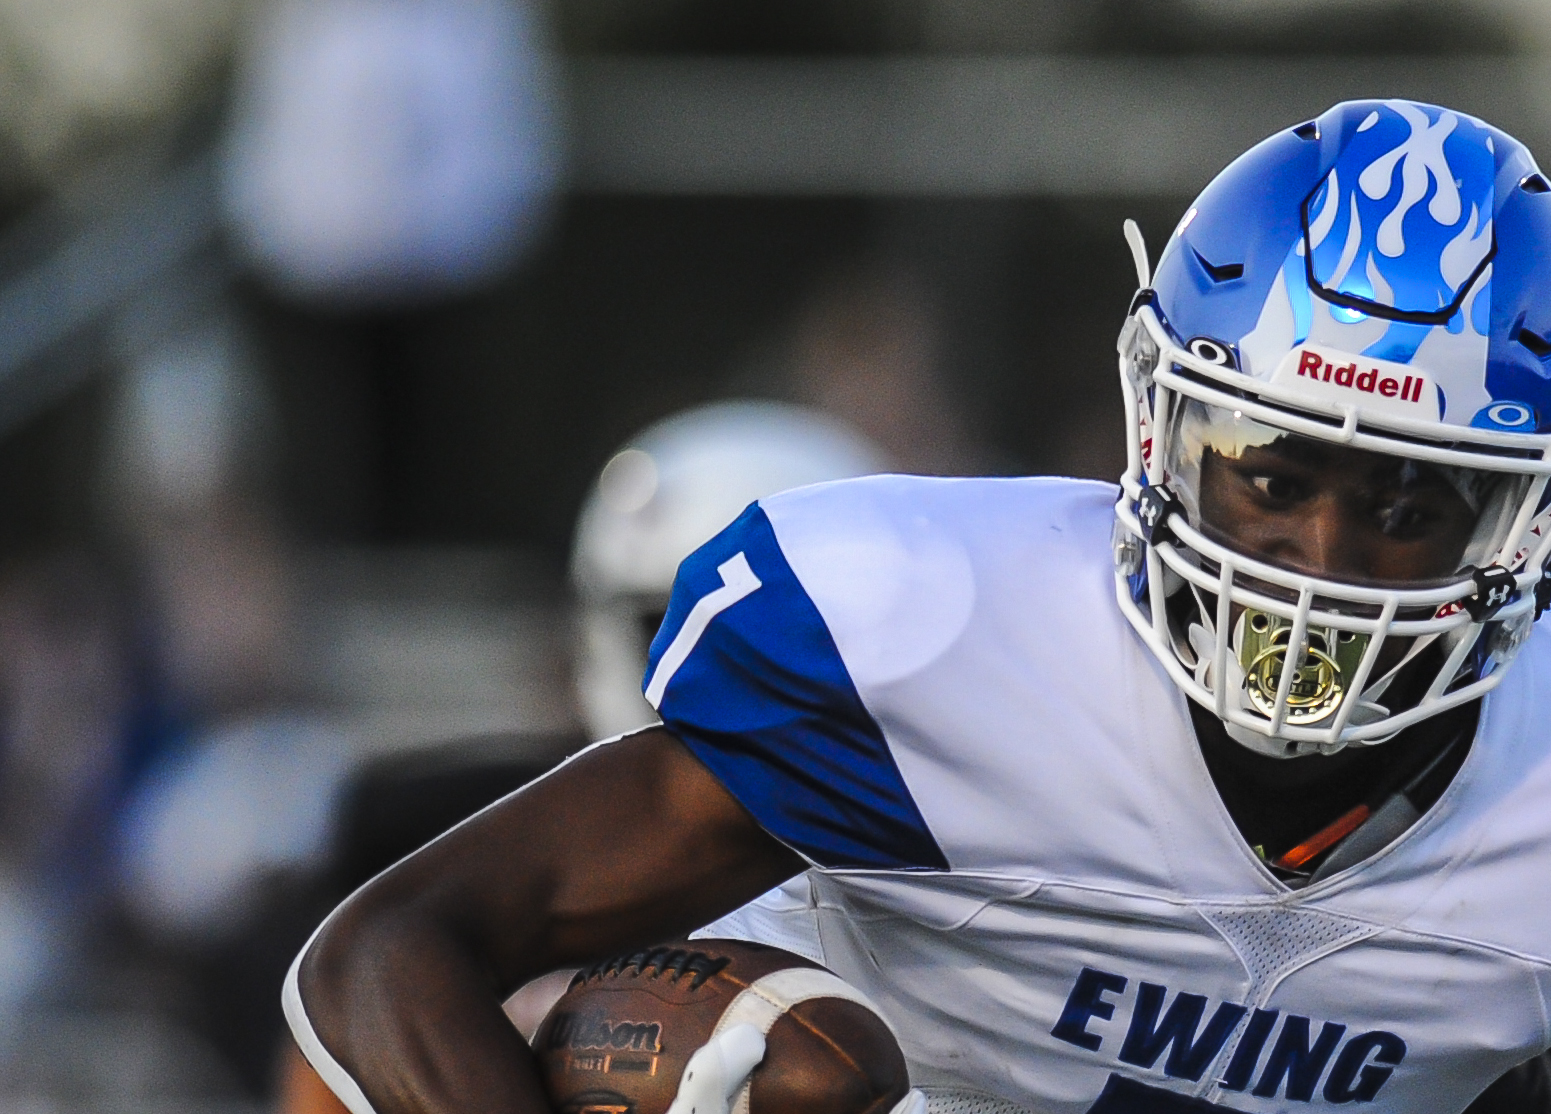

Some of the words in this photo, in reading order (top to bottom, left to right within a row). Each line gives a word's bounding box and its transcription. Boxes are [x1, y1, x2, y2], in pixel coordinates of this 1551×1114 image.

[1297, 350, 1424, 402] Riddell
[645, 551, 762, 711] 7
[1050, 967, 1407, 1102] EWING
